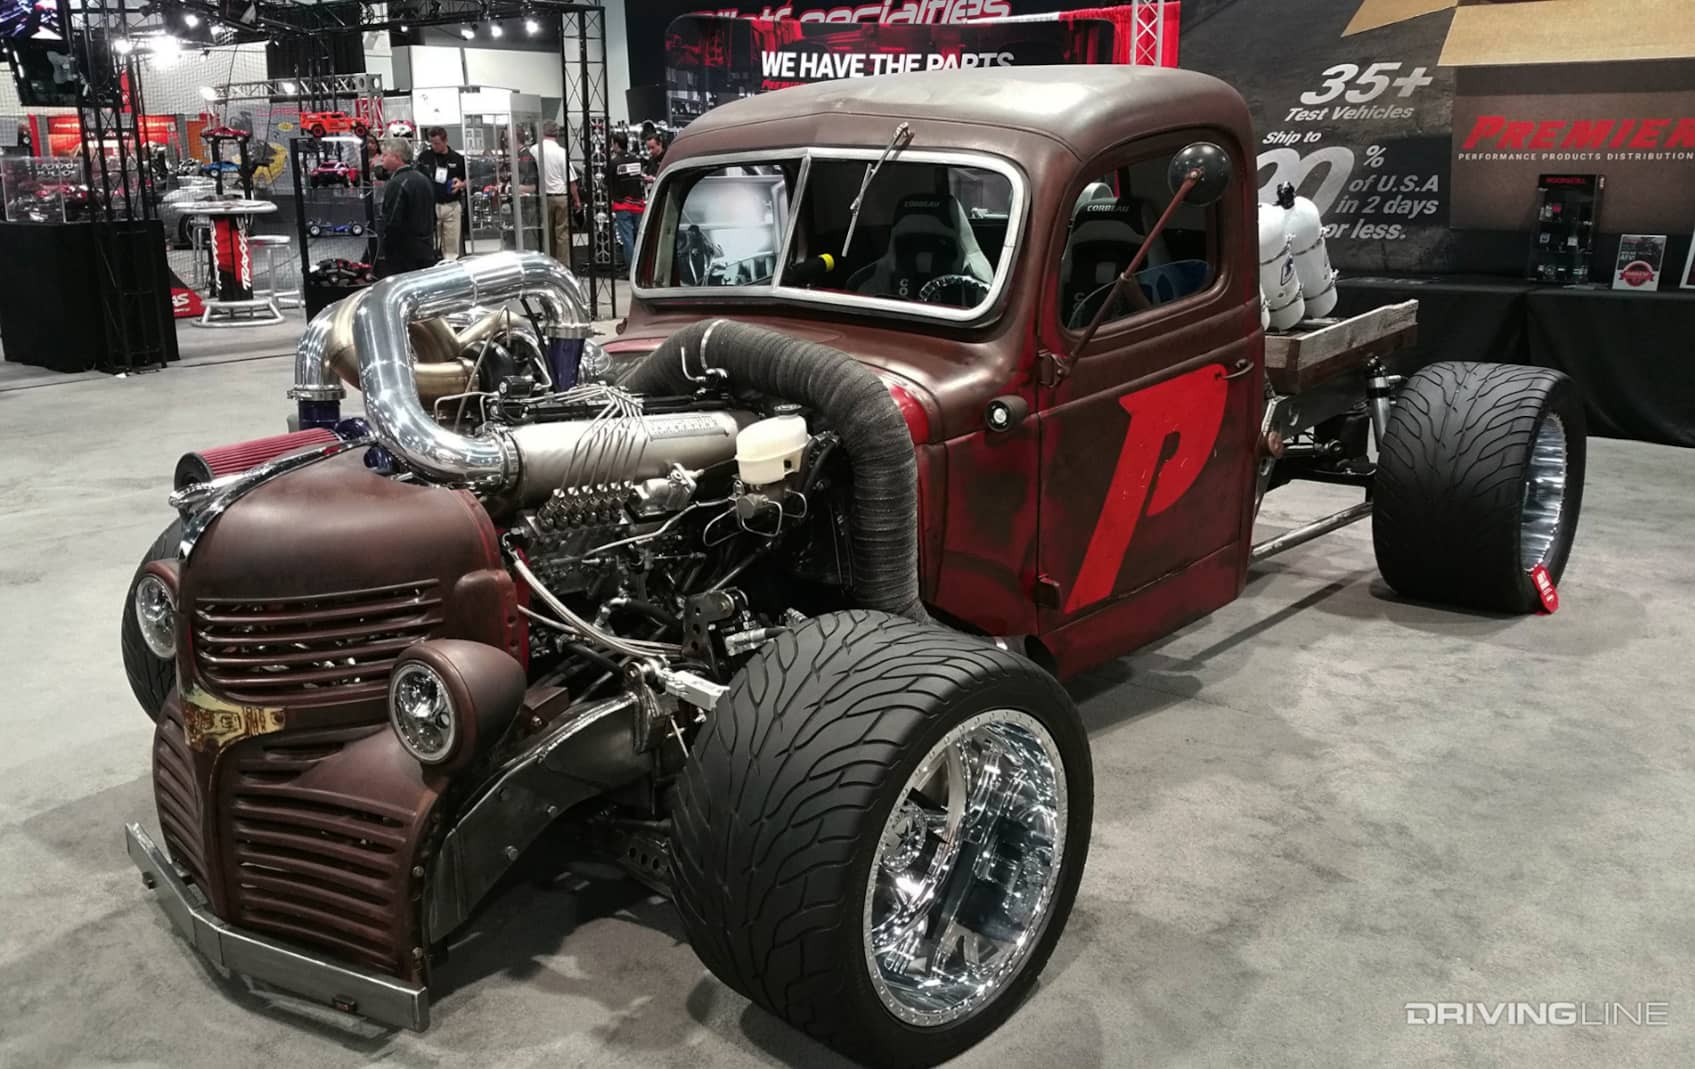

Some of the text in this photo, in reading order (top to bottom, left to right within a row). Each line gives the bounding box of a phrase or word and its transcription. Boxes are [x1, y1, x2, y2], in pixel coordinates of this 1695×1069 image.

[761, 51, 796, 77] WE
[799, 52, 866, 78] HAVE
[869, 53, 922, 76] THE
[1300, 62, 1433, 104] 35+
[1284, 105, 1415, 121] Test Vehicles
[1262, 131, 1322, 146] Ship to
[1462, 115, 1695, 150] PREMIER
[1458, 152, 1694, 161] PERFORMANCE PRODUCTS DISTRIBUTION
[1349, 175, 1439, 192] of U.S.A
[1335, 195, 1439, 218] in 2 days
[1326, 218, 1407, 239] or less.
